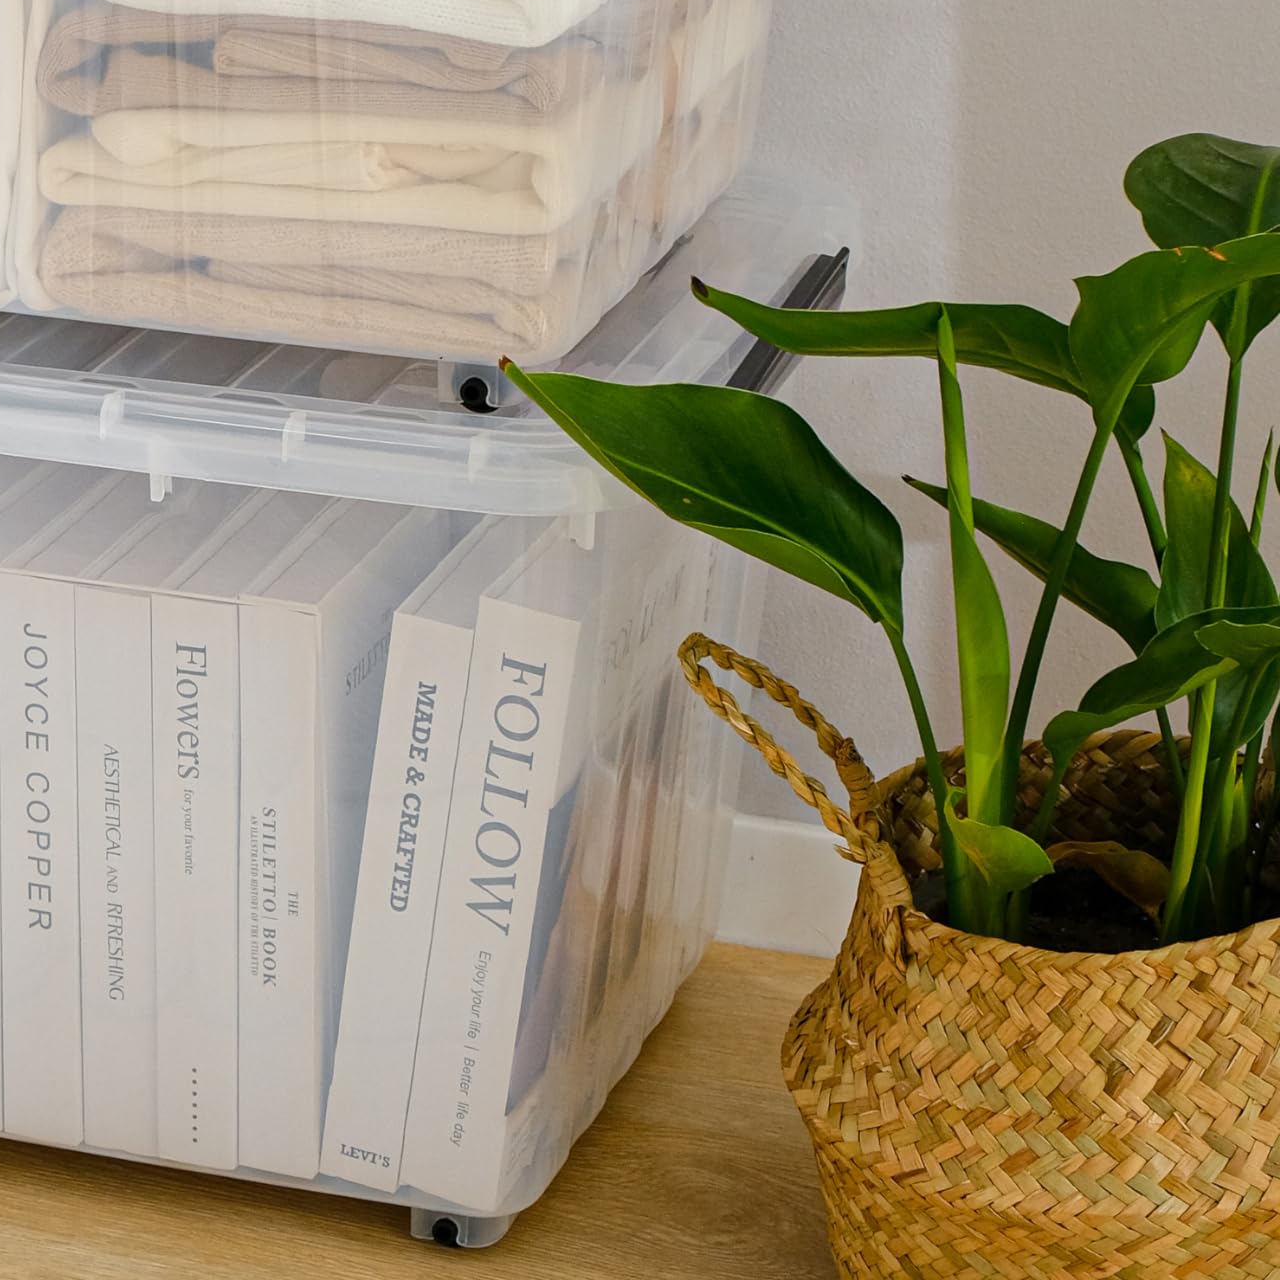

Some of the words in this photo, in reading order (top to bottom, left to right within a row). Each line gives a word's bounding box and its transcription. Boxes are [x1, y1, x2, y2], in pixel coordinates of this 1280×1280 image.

[23, 622, 50, 753] JOYCE
[175, 641, 208, 780] Flowers
[407, 682, 438, 760] MADE
[406, 765, 425, 785] &
[103, 744, 122, 861] AESTHETICAL
[183, 788, 194, 804] for
[465, 652, 547, 936] FOLLOW
[182, 806, 192, 831] your
[26, 771, 52, 930] COPPER
[183, 834, 196, 875] favorite
[389, 791, 423, 912] CRAFTED
[106, 865, 119, 894] AND
[288, 891, 299, 918] THE
[262, 927, 276, 987] BOOK
[472, 951, 492, 986] Enjoy
[470, 989, 483, 1018] your
[467, 1020, 481, 1039] life
[460, 1057, 476, 1096] Better
[456, 1102, 469, 1120] life
[449, 1123, 465, 1147] day
